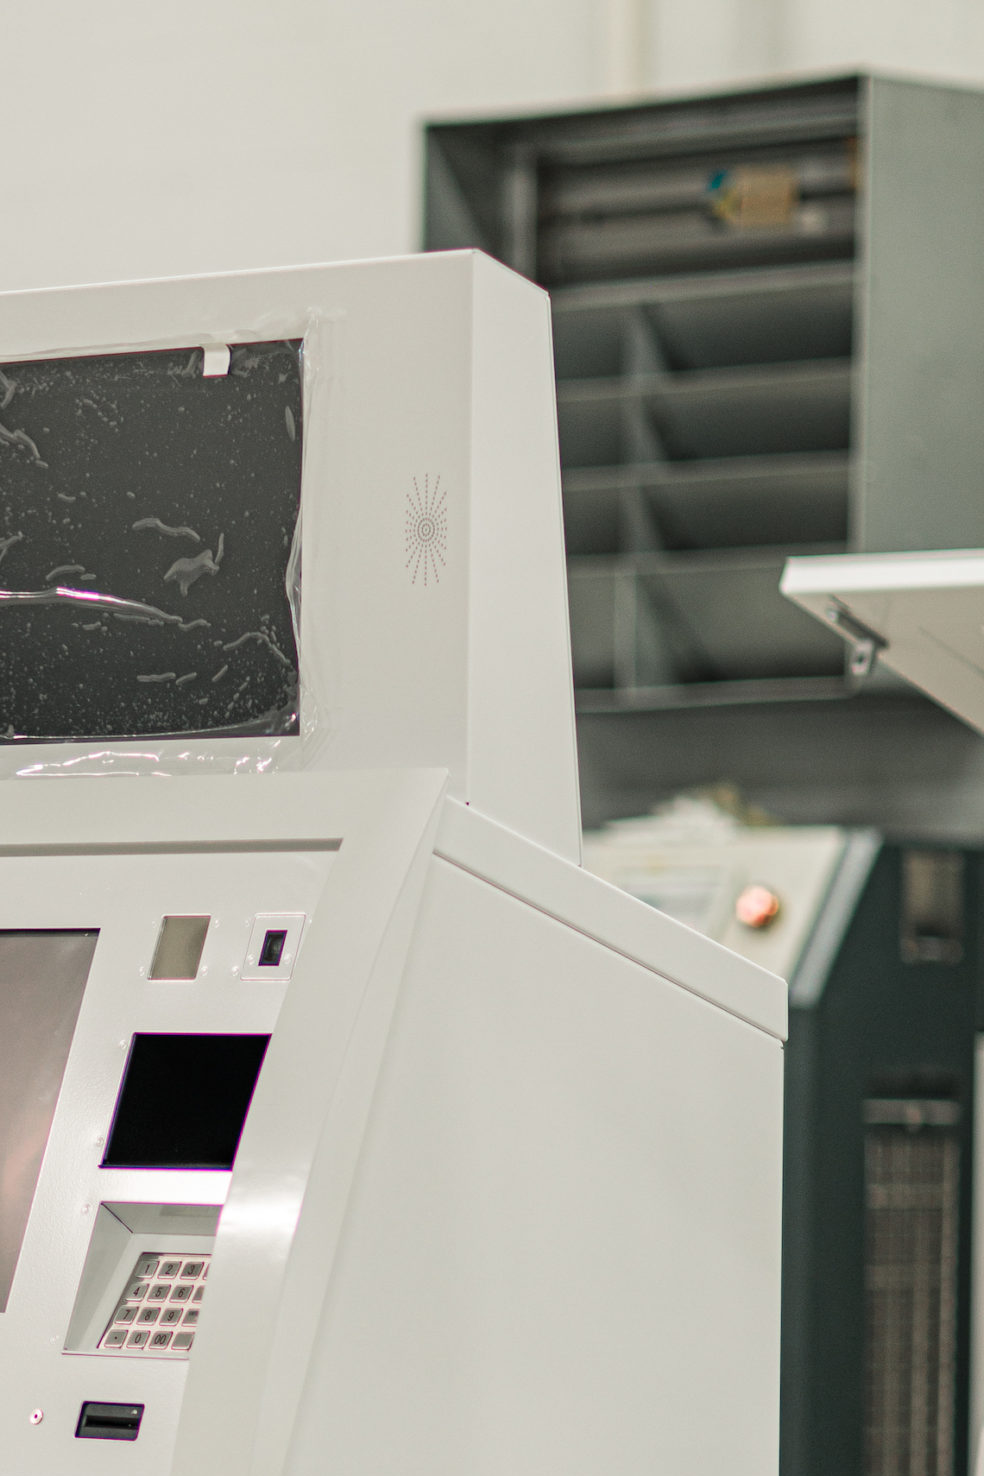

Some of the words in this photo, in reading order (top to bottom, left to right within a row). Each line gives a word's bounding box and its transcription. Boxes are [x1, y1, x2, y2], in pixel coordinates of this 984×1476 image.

[144, 1264, 151, 1274] 1
[165, 1264, 174, 1275] 2
[187, 1264, 196, 1275] 3
[133, 1286, 140, 1296] 4
[155, 1287, 163, 1298] 5
[178, 1288, 186, 1298] 6
[123, 1309, 131, 1320] 7
[144, 1310, 152, 1321] 8
[167, 1311, 175, 1321] 9
[134, 1333, 142, 1344] 0
